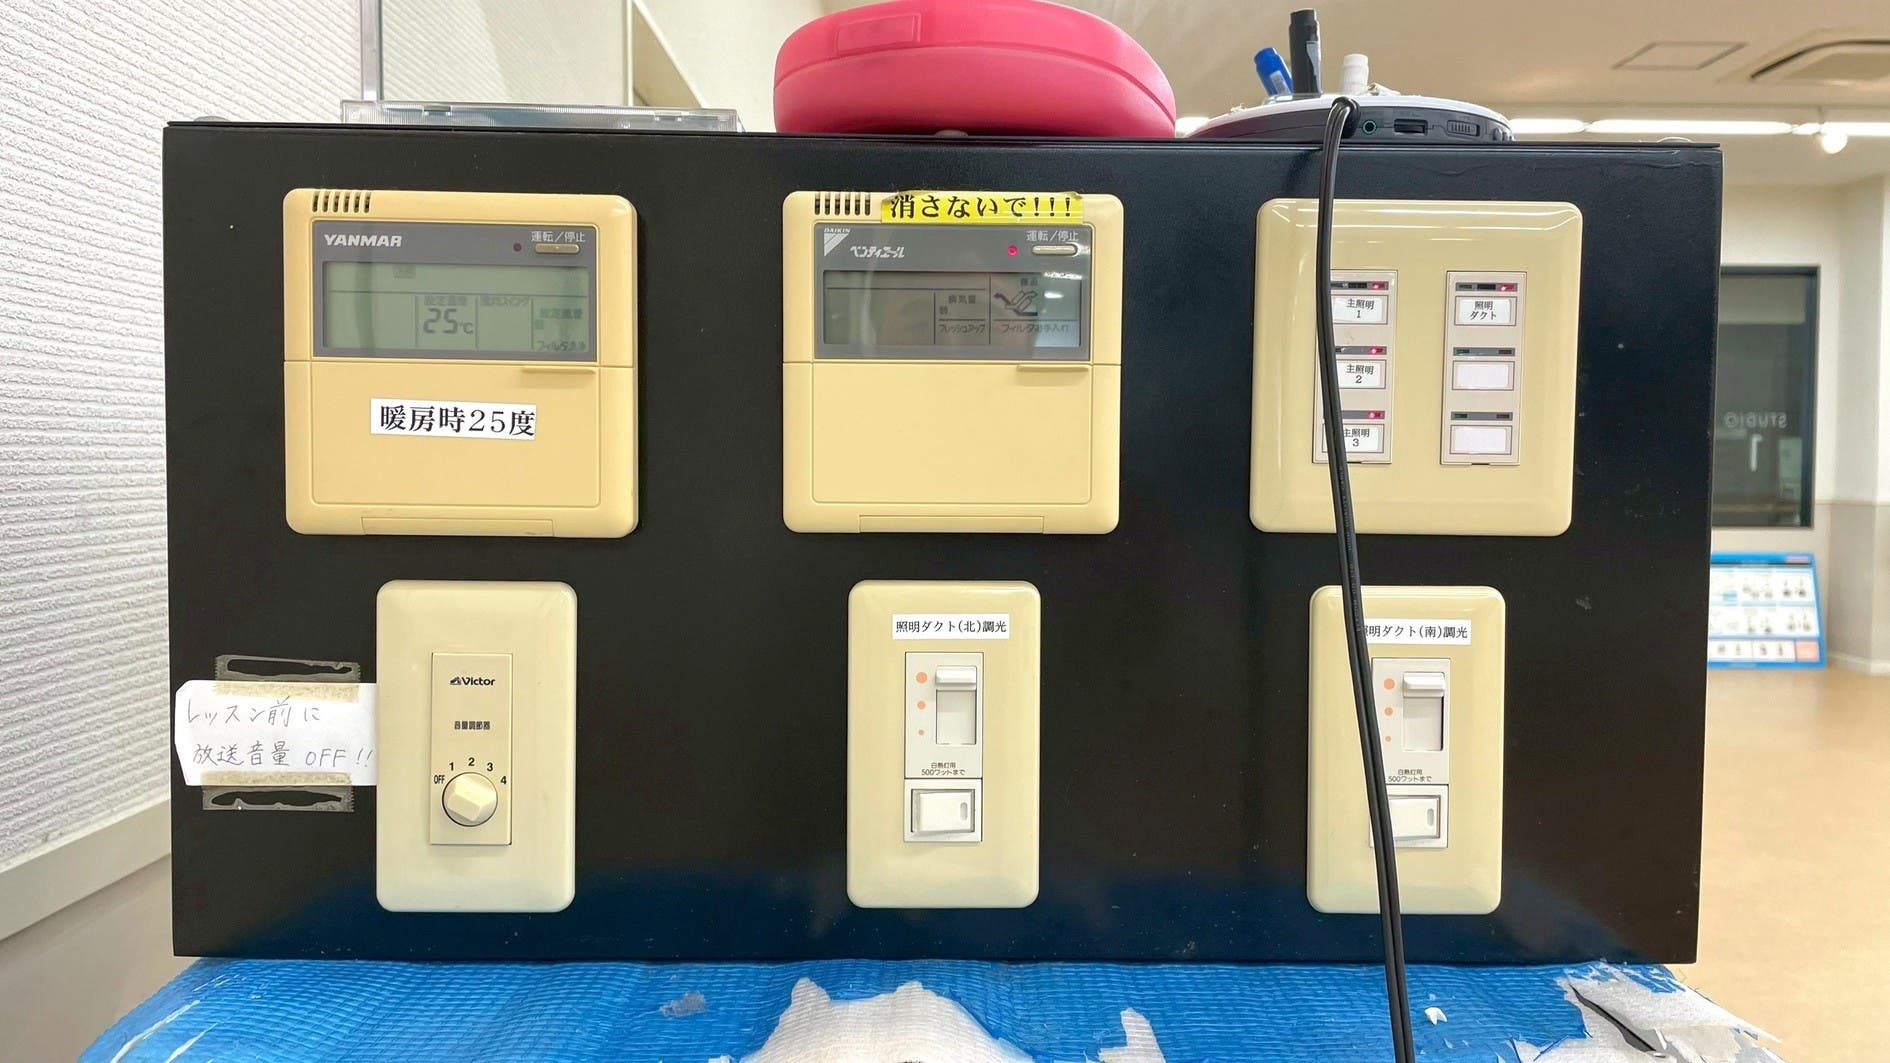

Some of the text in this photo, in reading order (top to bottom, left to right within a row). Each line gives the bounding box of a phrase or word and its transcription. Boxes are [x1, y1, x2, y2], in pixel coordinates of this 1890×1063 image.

[890, 194, 1072, 219] 消さないで!!!
[324, 234, 402, 248] YANMAR
[531, 230, 586, 243] 運転／停止
[1026, 230, 1079, 242] 運転/停止
[1346, 299, 1375, 310] 主照明
[1474, 301, 1493, 311] 照明
[1355, 310, 1361, 319] 1
[1469, 311, 1497, 320] ダクト
[1346, 364, 1374, 374] 主照明
[1355, 375, 1362, 384] 2
[380, 404, 536, 437] 暖房時25度
[1343, 428, 1370, 438] 主照明
[1352, 438, 1359, 447] 3
[895, 620, 1007, 634] 照明ダクト(北)調光
[461, 676, 496, 686] Victor
[187, 695, 321, 728] レッスン前に
[192, 740, 290, 767] 放送音量
[433, 757, 507, 785] OFF 1 2 3 4
[921, 768, 966, 777] 500ワットまで
[1388, 775, 1433, 783] 500ワットまで
